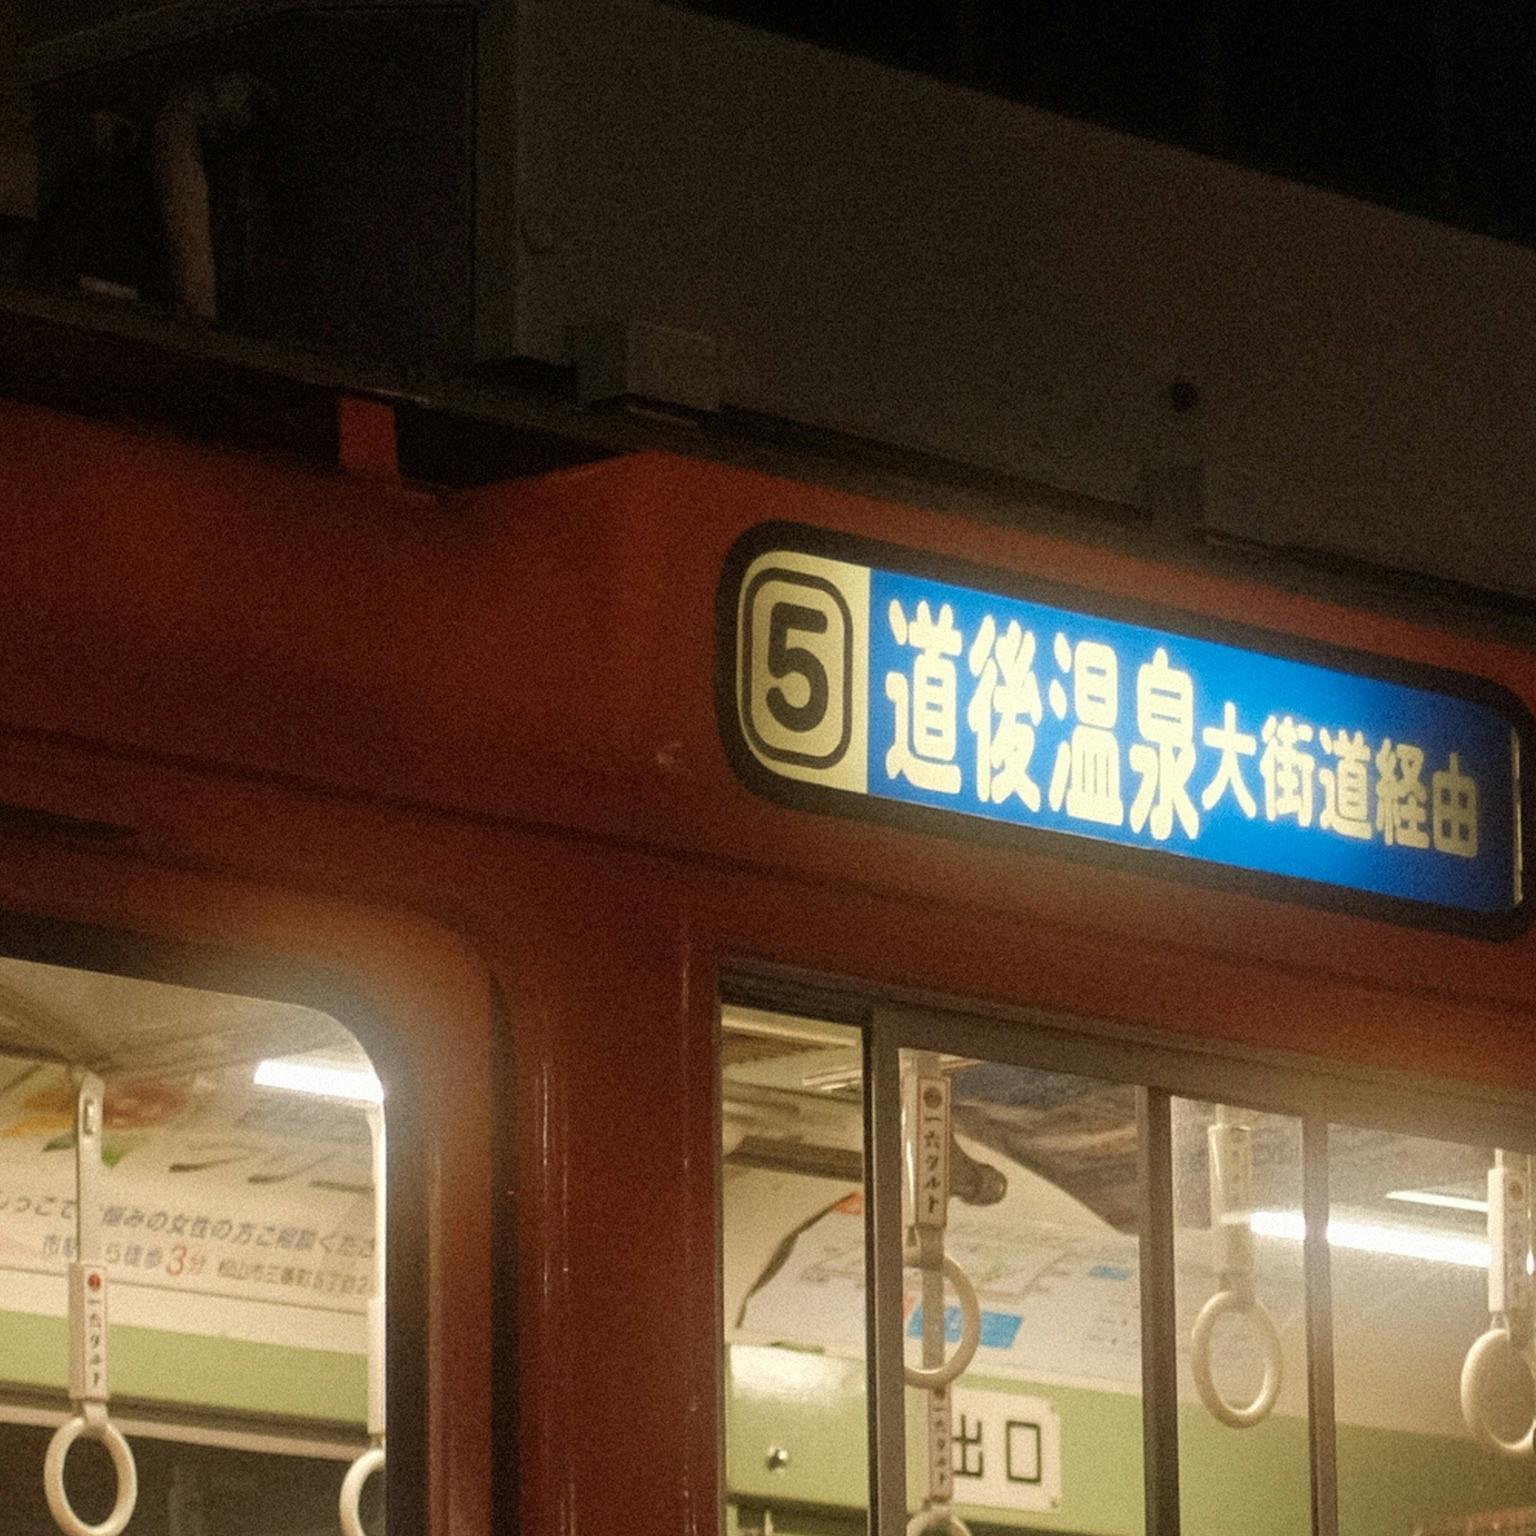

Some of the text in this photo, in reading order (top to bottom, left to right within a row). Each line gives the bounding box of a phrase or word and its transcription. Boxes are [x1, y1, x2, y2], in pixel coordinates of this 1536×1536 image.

[766, 600, 830, 733] 5
[884, 598, 1479, 859] 道後温泉 大街道経由
[952, 1413, 1042, 1485] 出口
